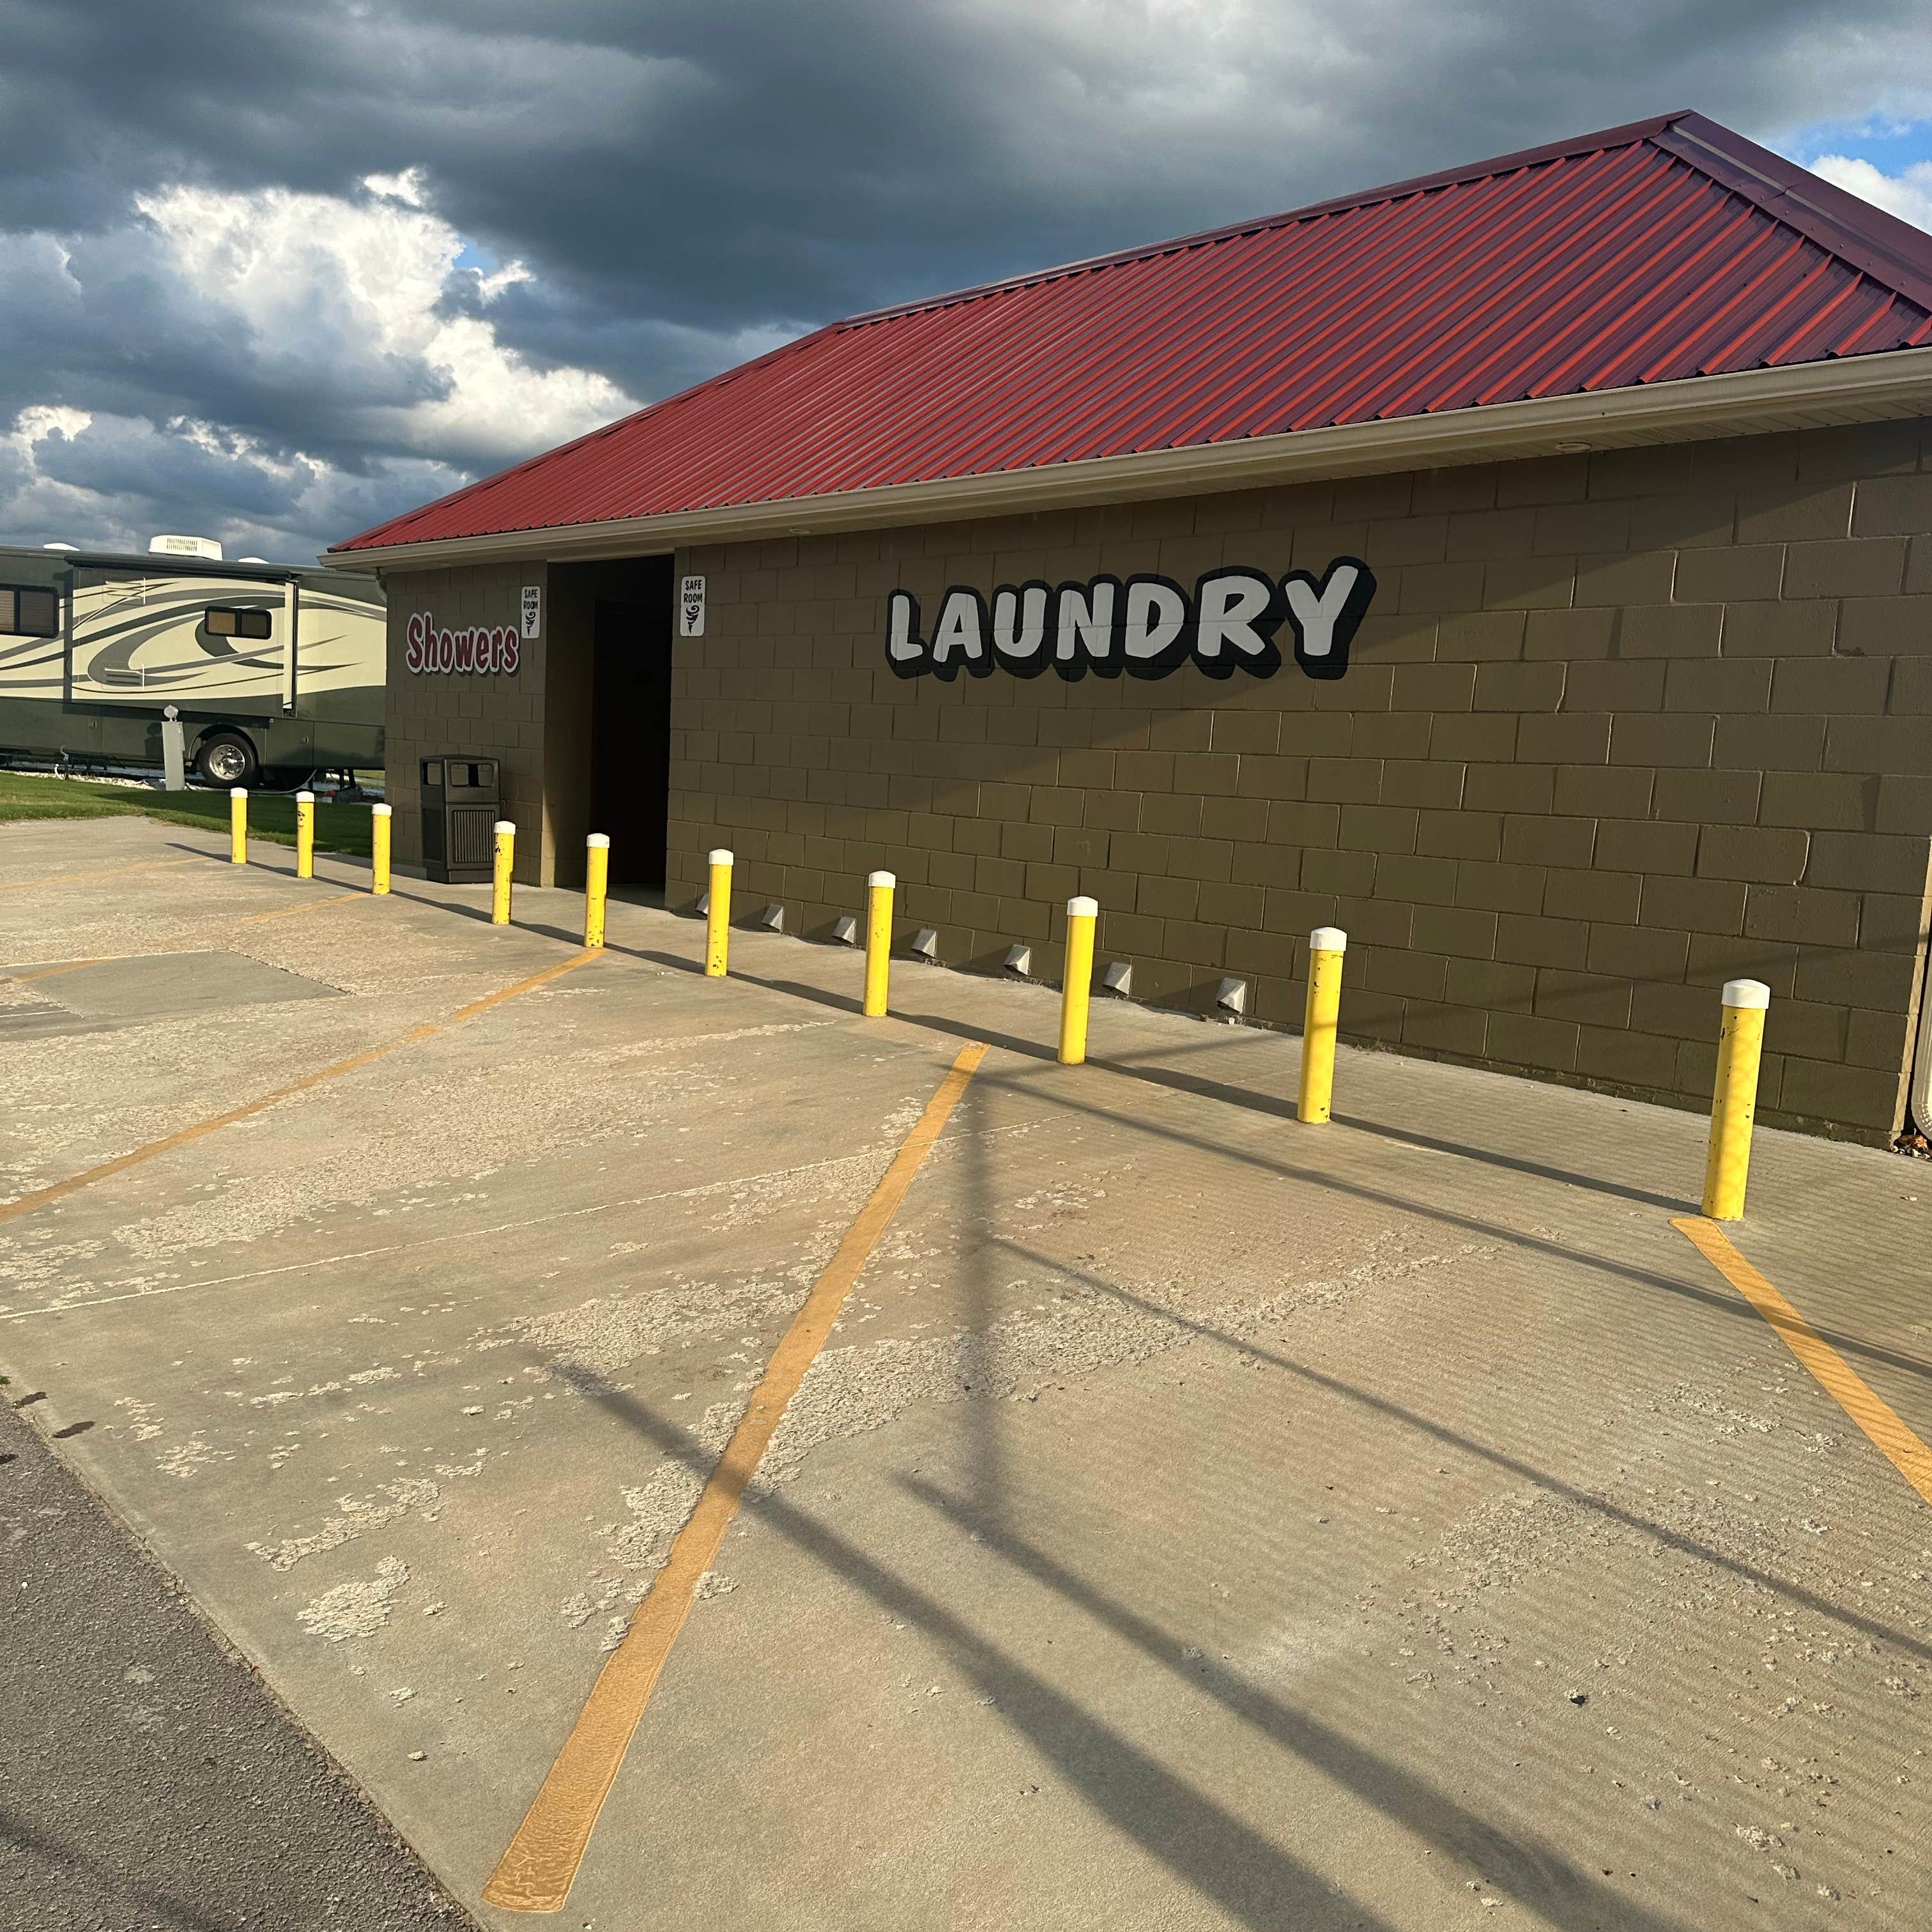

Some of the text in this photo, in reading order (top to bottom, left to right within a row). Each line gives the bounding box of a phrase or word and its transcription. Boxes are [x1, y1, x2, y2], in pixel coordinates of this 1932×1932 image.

[686, 579, 702, 591] SAFE
[525, 589, 538, 599] SAFE
[684, 593, 703, 604] ROOM
[524, 601, 538, 610] ROOM
[891, 565, 1359, 663] LAUNDRY
[406, 611, 519, 673] Showers
